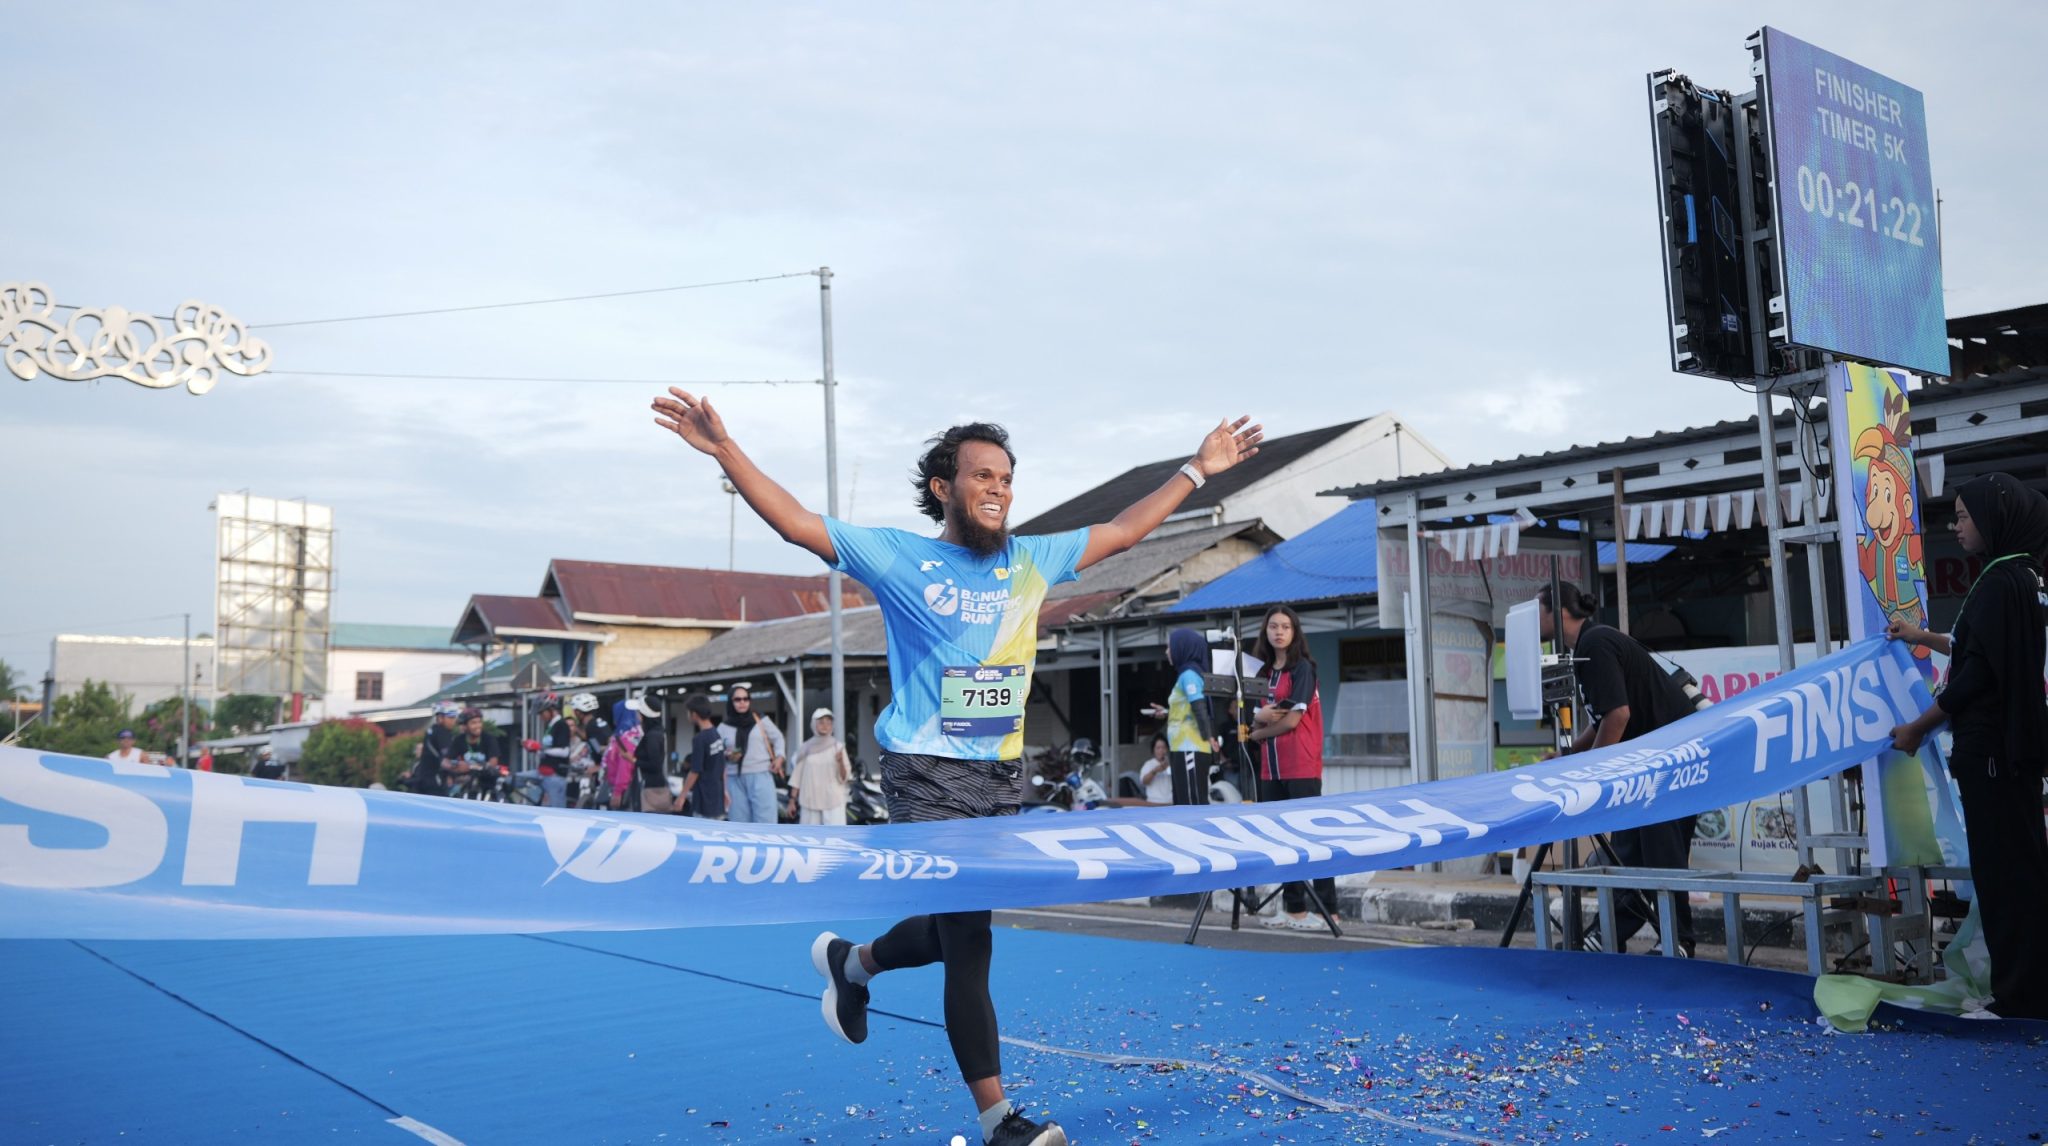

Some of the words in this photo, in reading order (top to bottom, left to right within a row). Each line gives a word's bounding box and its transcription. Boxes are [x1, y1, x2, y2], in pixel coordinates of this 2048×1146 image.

[1815, 68, 1903, 128] FINISHER
[1817, 106, 1878, 154] TIMER
[1884, 132, 1906, 165] 5K
[1798, 165, 1924, 247] 00:21:22
[961, 588, 1010, 602] BANUA
[961, 611, 994, 625] RUN
[962, 688, 1011, 707] 7139
[1605, 770, 1668, 809] RUN
[1669, 761, 1710, 792] 2025
[1014, 798, 1489, 880] FINISH
[1751, 839, 1777, 850] Rujak
[688, 845, 838, 884] RUN
[858, 850, 959, 880] 2025
